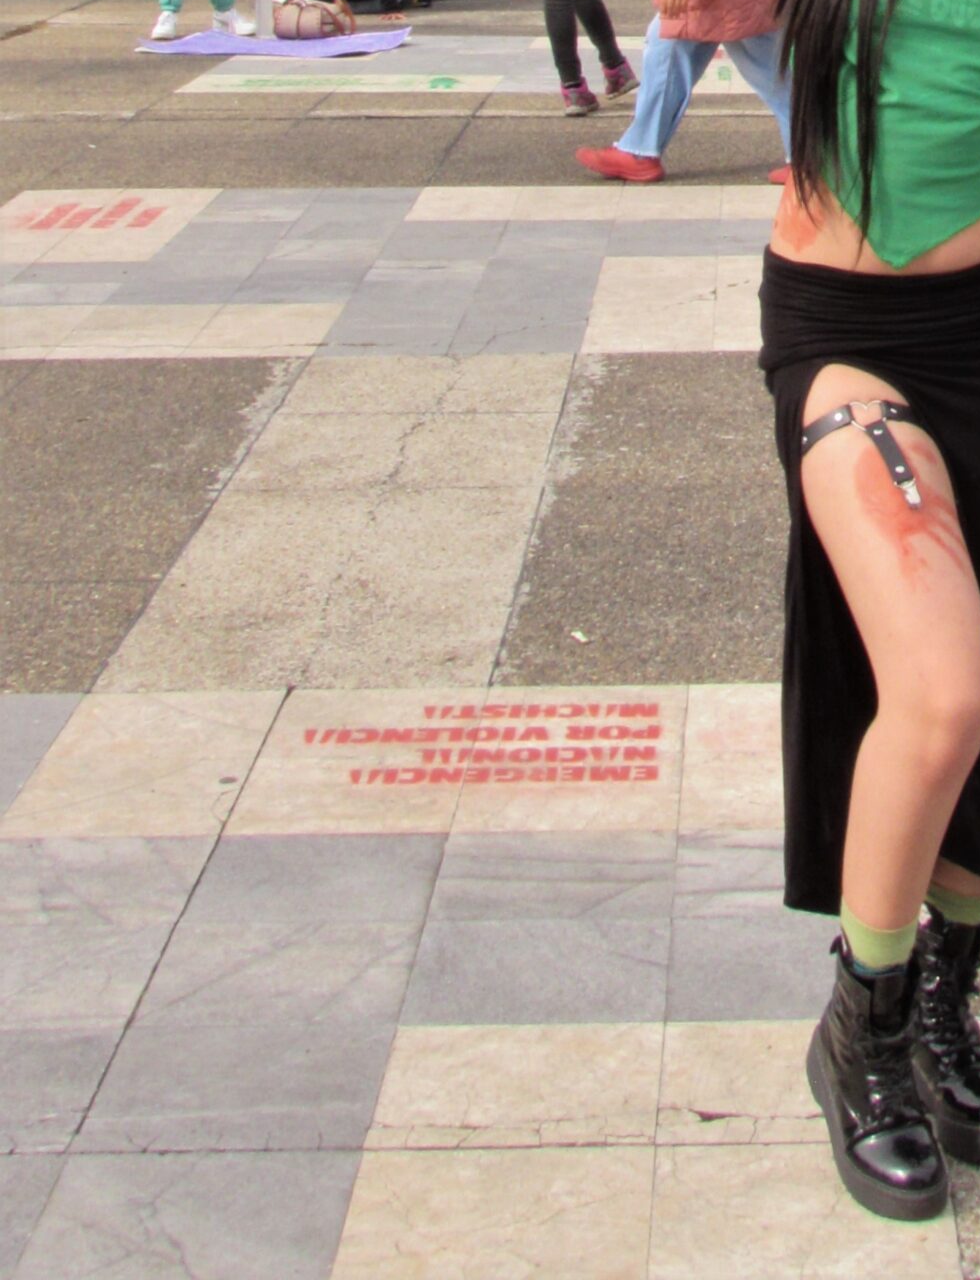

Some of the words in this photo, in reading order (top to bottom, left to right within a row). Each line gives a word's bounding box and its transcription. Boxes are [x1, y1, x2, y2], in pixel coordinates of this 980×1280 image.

[424, 703, 660, 719] MACHISTA
[304, 726, 549, 745] VIOLENCIA
[565, 724, 662, 742] POR
[418, 746, 658, 764] NACIONAL
[349, 766, 660, 786] EMERGENCIA
